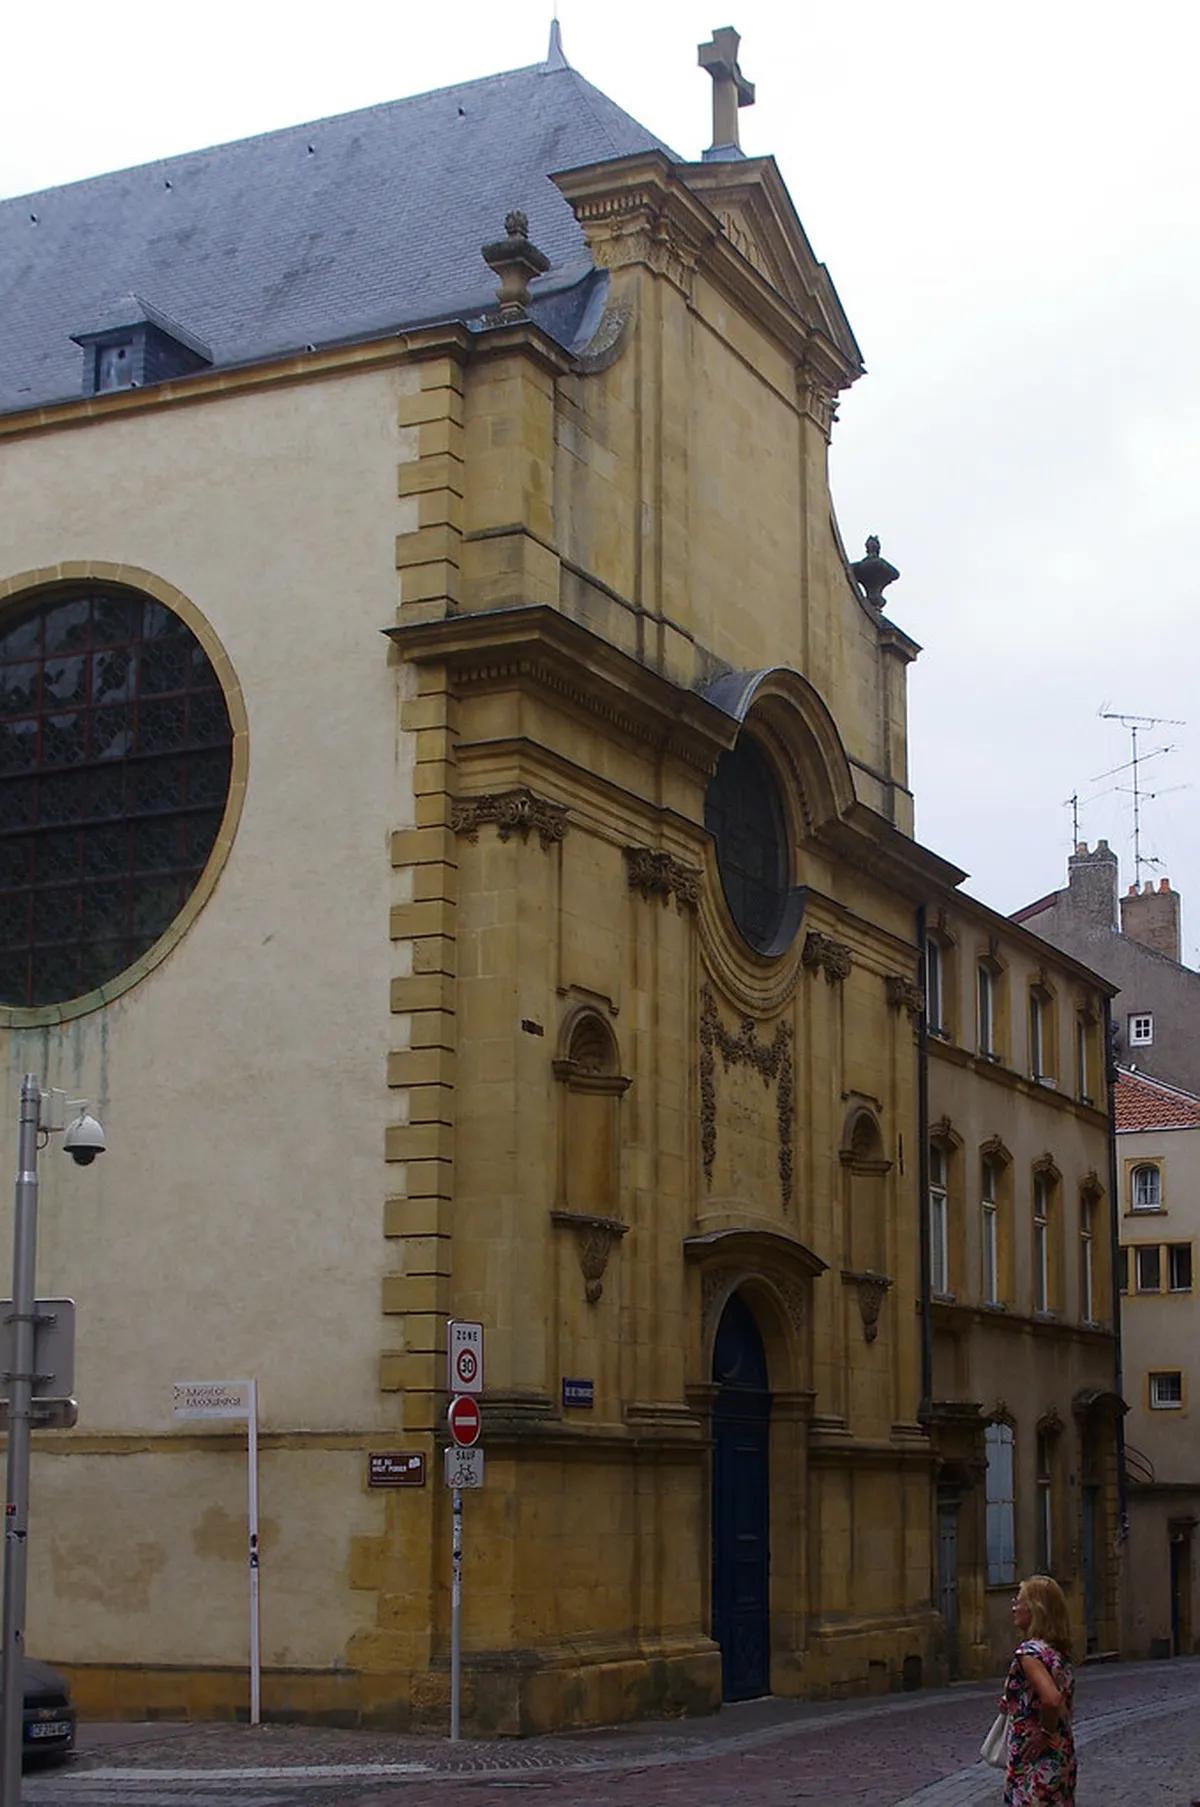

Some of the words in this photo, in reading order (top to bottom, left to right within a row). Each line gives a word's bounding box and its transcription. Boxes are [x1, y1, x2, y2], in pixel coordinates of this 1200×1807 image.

[456, 1330, 477, 1342] ZONE
[461, 1358, 473, 1374] 30
[456, 1450, 475, 1461] SAUF
